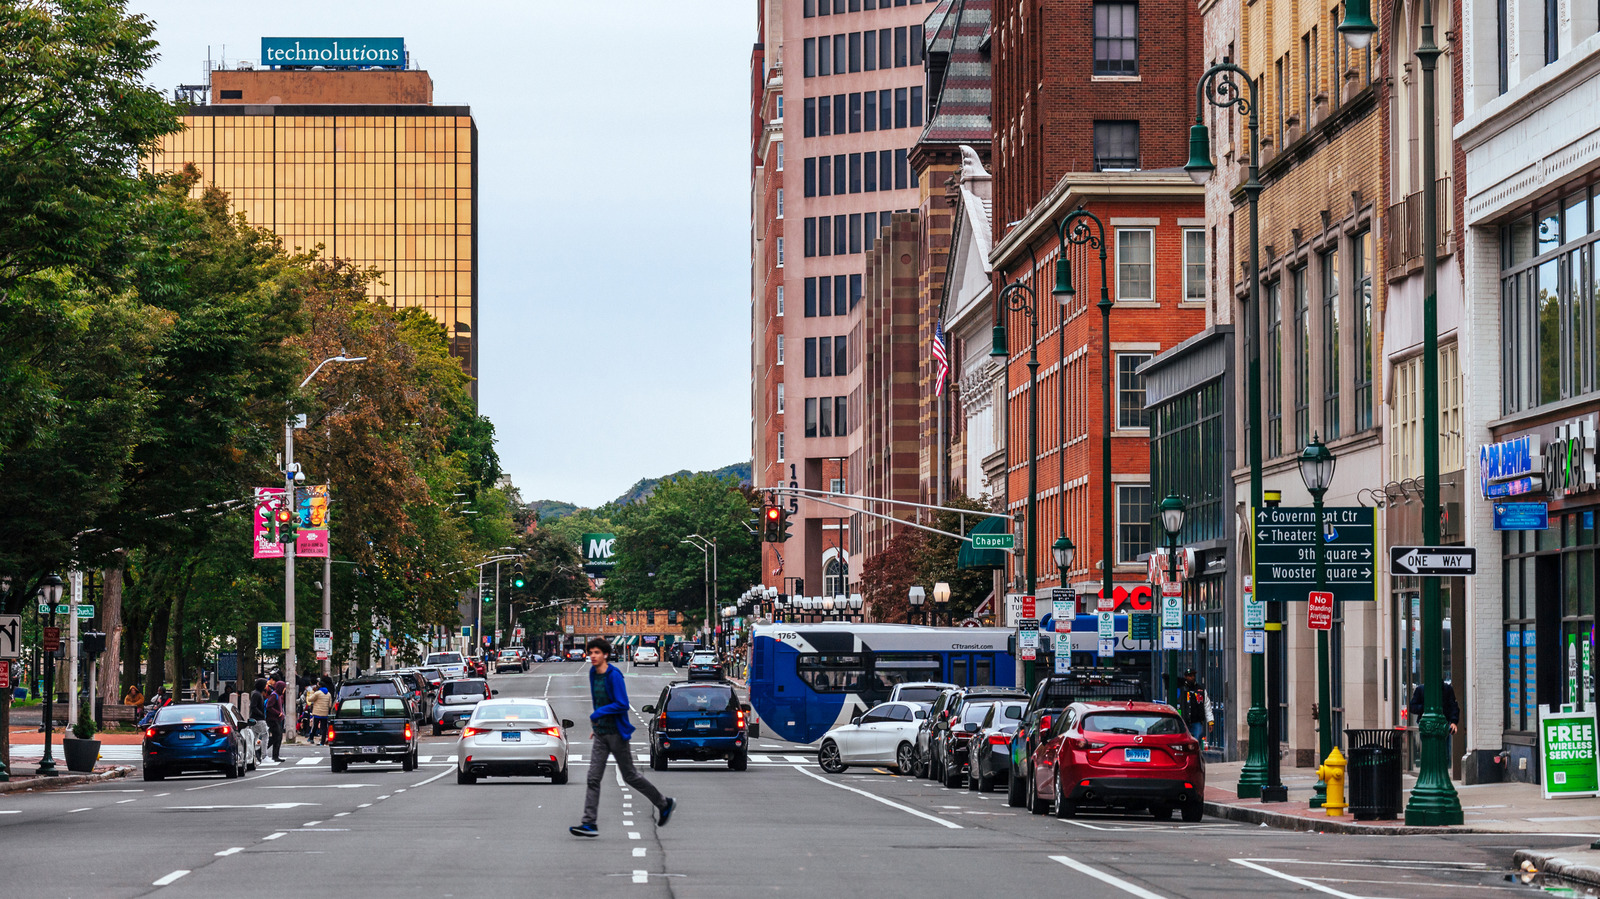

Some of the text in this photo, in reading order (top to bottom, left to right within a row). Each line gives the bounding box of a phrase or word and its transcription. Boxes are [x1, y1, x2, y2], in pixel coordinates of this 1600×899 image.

[267, 41, 399, 61] technolutions
[1545, 421, 1588, 494] cricket
[1342, 511, 1357, 522] Ctr
[1272, 529, 1316, 541] Theaters
[976, 537, 1004, 546] Chapel
[1298, 548, 1357, 562] 9th quare
[1408, 556, 1462, 566] ONE WAY
[1272, 567, 1357, 581] Wooster quare
[1315, 596, 1326, 604] No
[1310, 604, 1331, 613] Standing
[1547, 725, 1592, 742] FREE
[1548, 742, 1592, 750] WIRELESS
[1549, 750, 1593, 760] SERVICE
